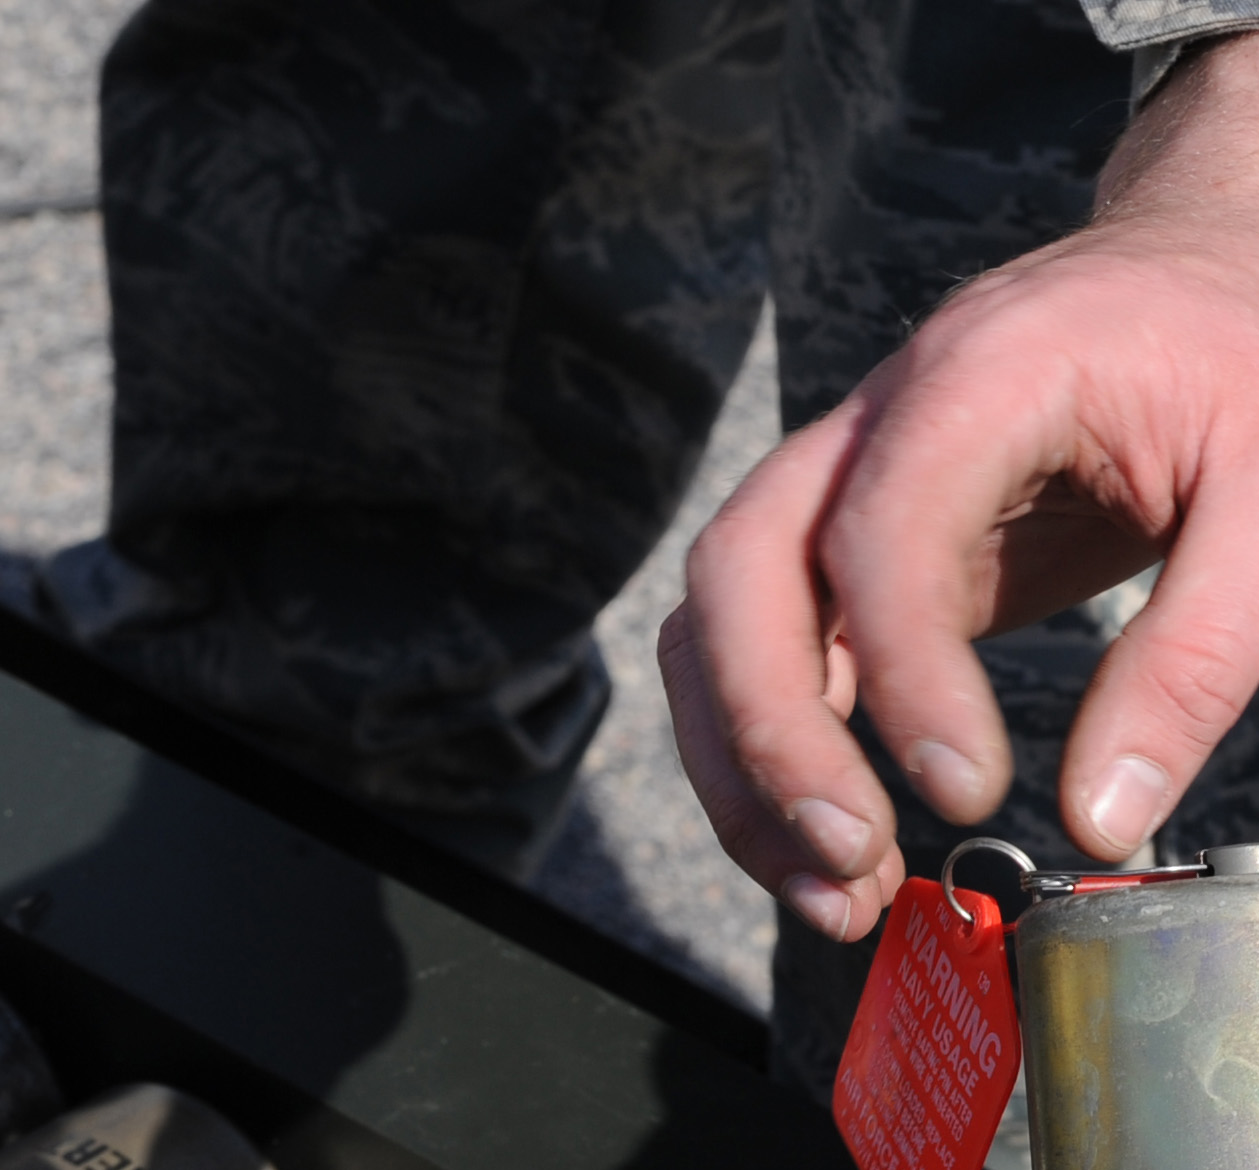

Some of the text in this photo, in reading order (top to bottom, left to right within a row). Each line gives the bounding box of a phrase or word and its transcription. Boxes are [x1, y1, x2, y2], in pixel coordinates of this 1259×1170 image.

[898, 954, 979, 1097] NAVY USAGE
[905, 902, 1002, 1079] WARNING
[840, 1066, 863, 1109] AIR
